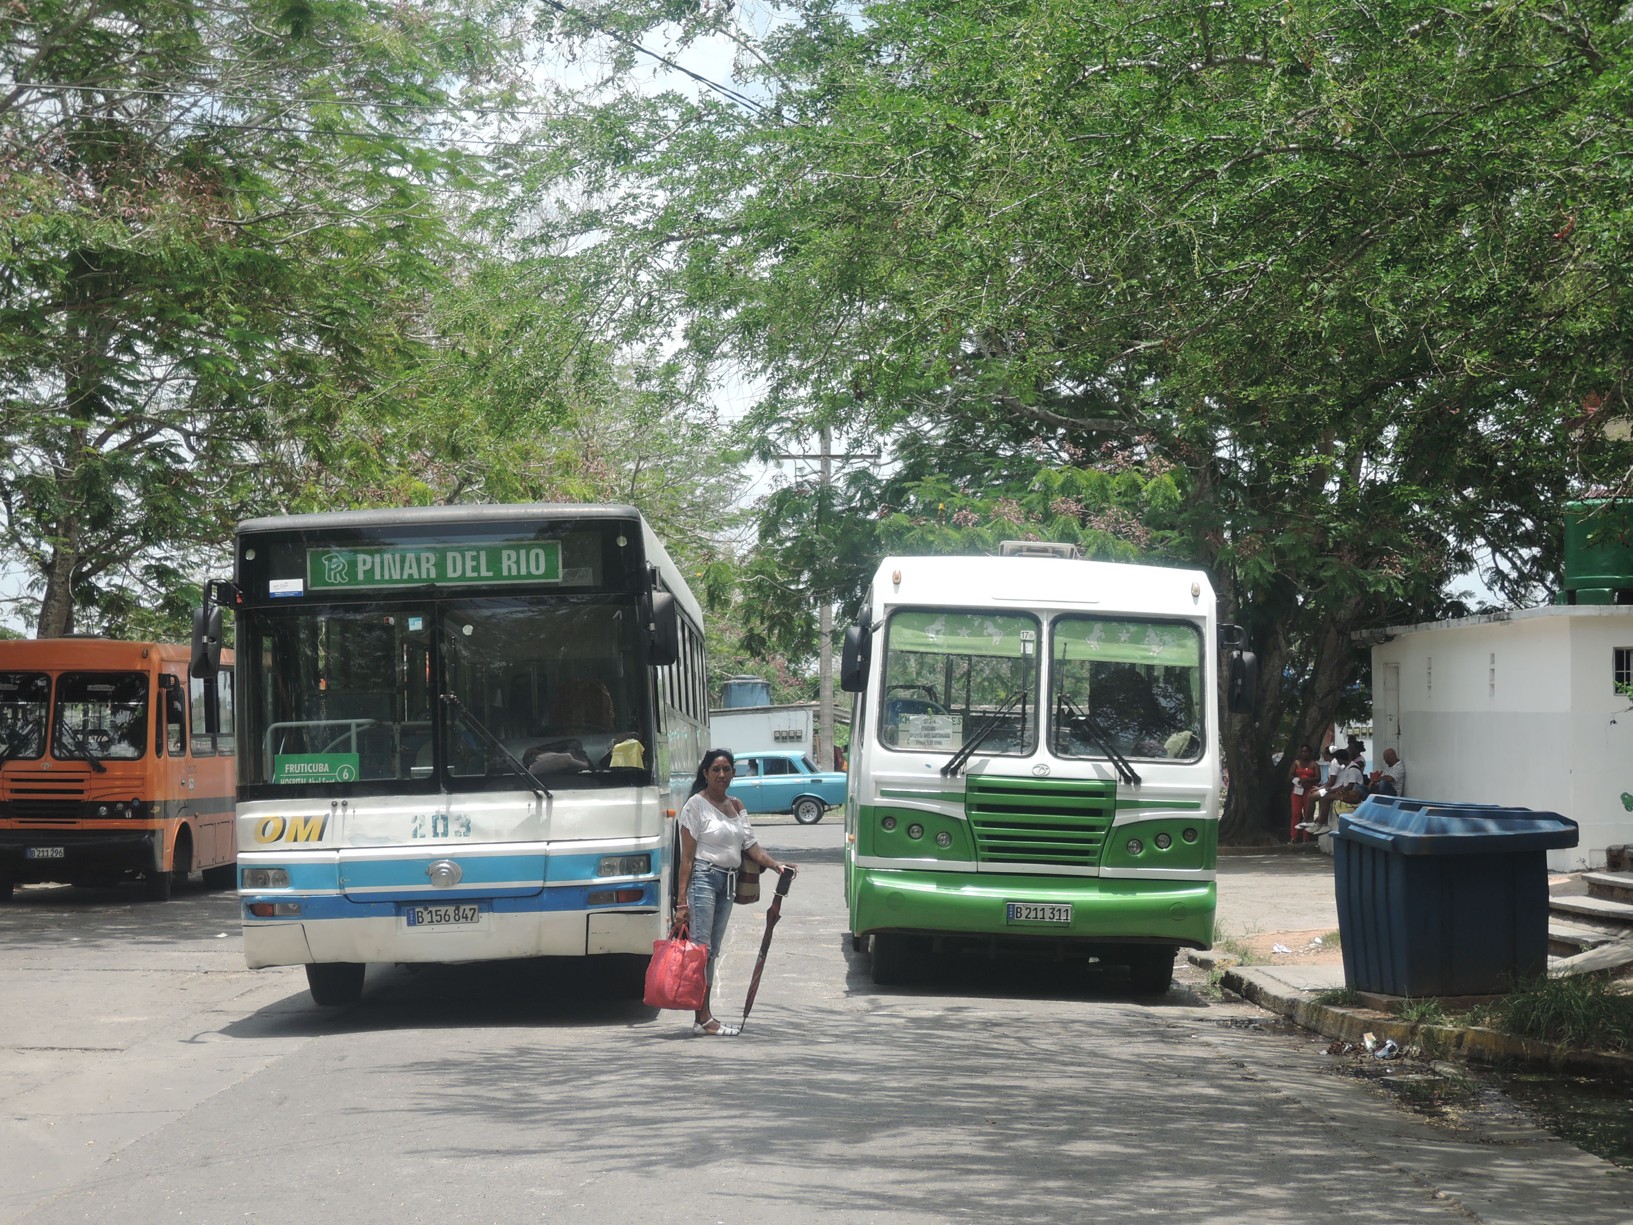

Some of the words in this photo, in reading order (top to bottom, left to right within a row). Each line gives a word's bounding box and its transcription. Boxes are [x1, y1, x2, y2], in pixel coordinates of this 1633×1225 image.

[356, 552, 437, 581] PINAR
[446, 550, 494, 578] DEL
[501, 548, 546, 576] RIO
[285, 763, 330, 774] FRUTICUBA
[342, 768, 349, 780] 6
[253, 812, 330, 844] OM
[411, 813, 472, 839] 203
